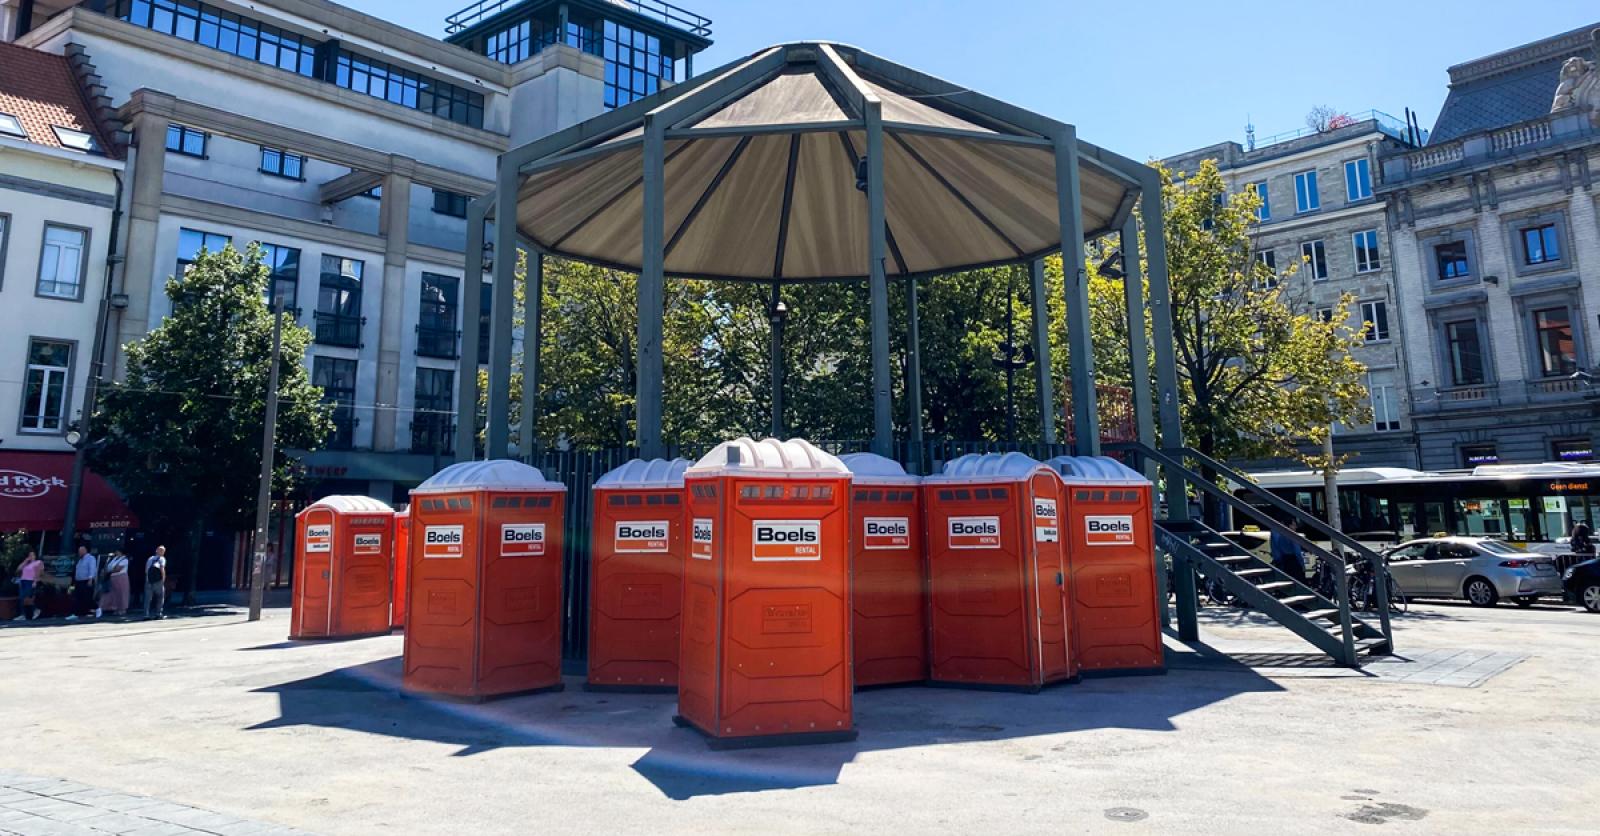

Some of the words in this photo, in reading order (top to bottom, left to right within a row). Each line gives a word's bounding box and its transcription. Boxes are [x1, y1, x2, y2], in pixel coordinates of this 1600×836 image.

[11, 475, 68, 488] Rock
[1036, 505, 1056, 516] Boels
[90, 521, 109, 529] ROCK
[111, 520, 130, 528] SHOP
[867, 523, 906, 534] Boels
[951, 523, 996, 534] Boels
[1088, 521, 1130, 532] Boels
[427, 531, 460, 543] Boels
[504, 529, 542, 541] Boels
[619, 527, 665, 538] Boels
[694, 525, 711, 540] Boels
[757, 527, 817, 542] Boels
[795, 546, 817, 554] RENTAL
